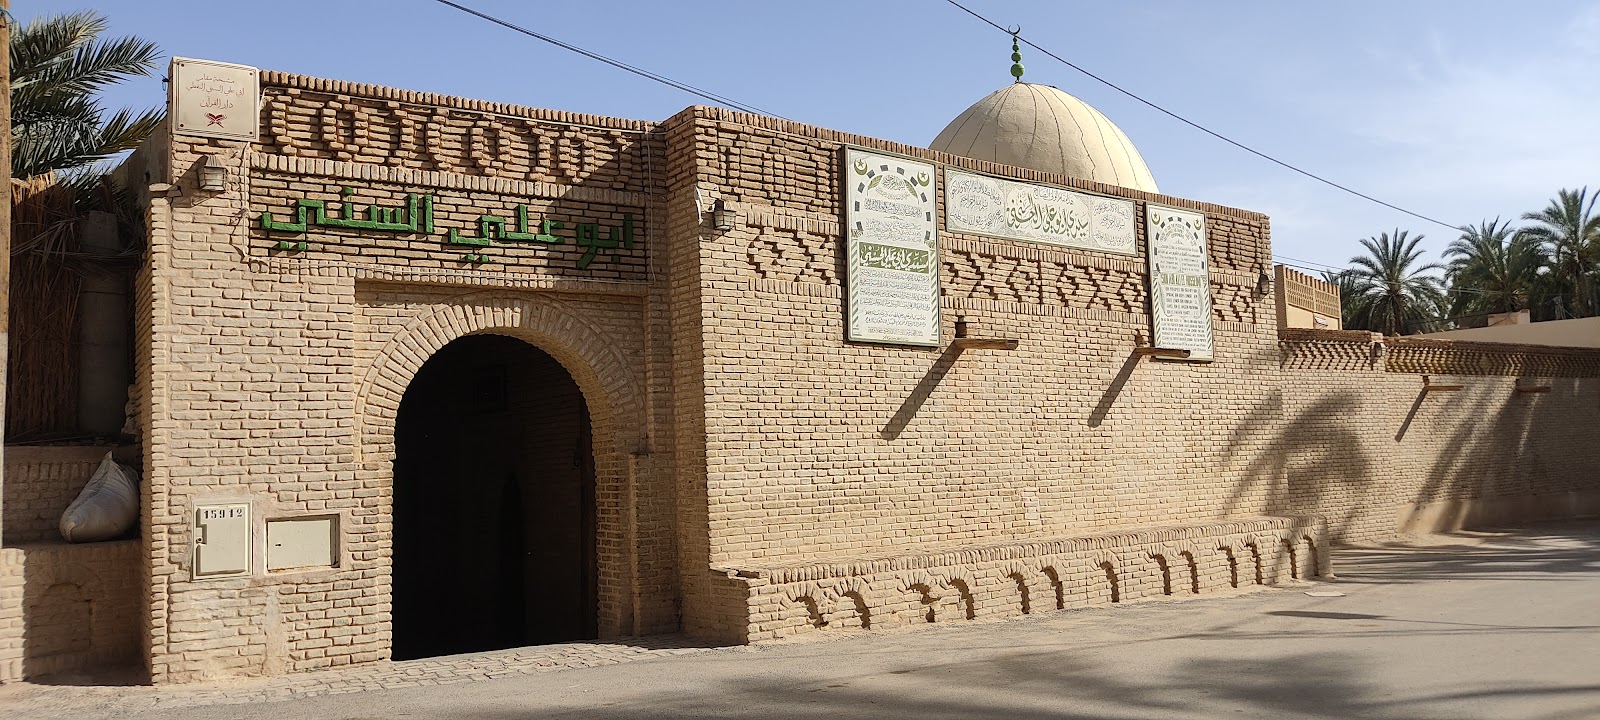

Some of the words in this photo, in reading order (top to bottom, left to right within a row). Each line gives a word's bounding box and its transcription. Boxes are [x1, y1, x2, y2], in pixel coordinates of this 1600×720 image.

[261, 187, 434, 250] السني
[450, 204, 565, 263] علي
[203, 508, 243, 519] 15912
